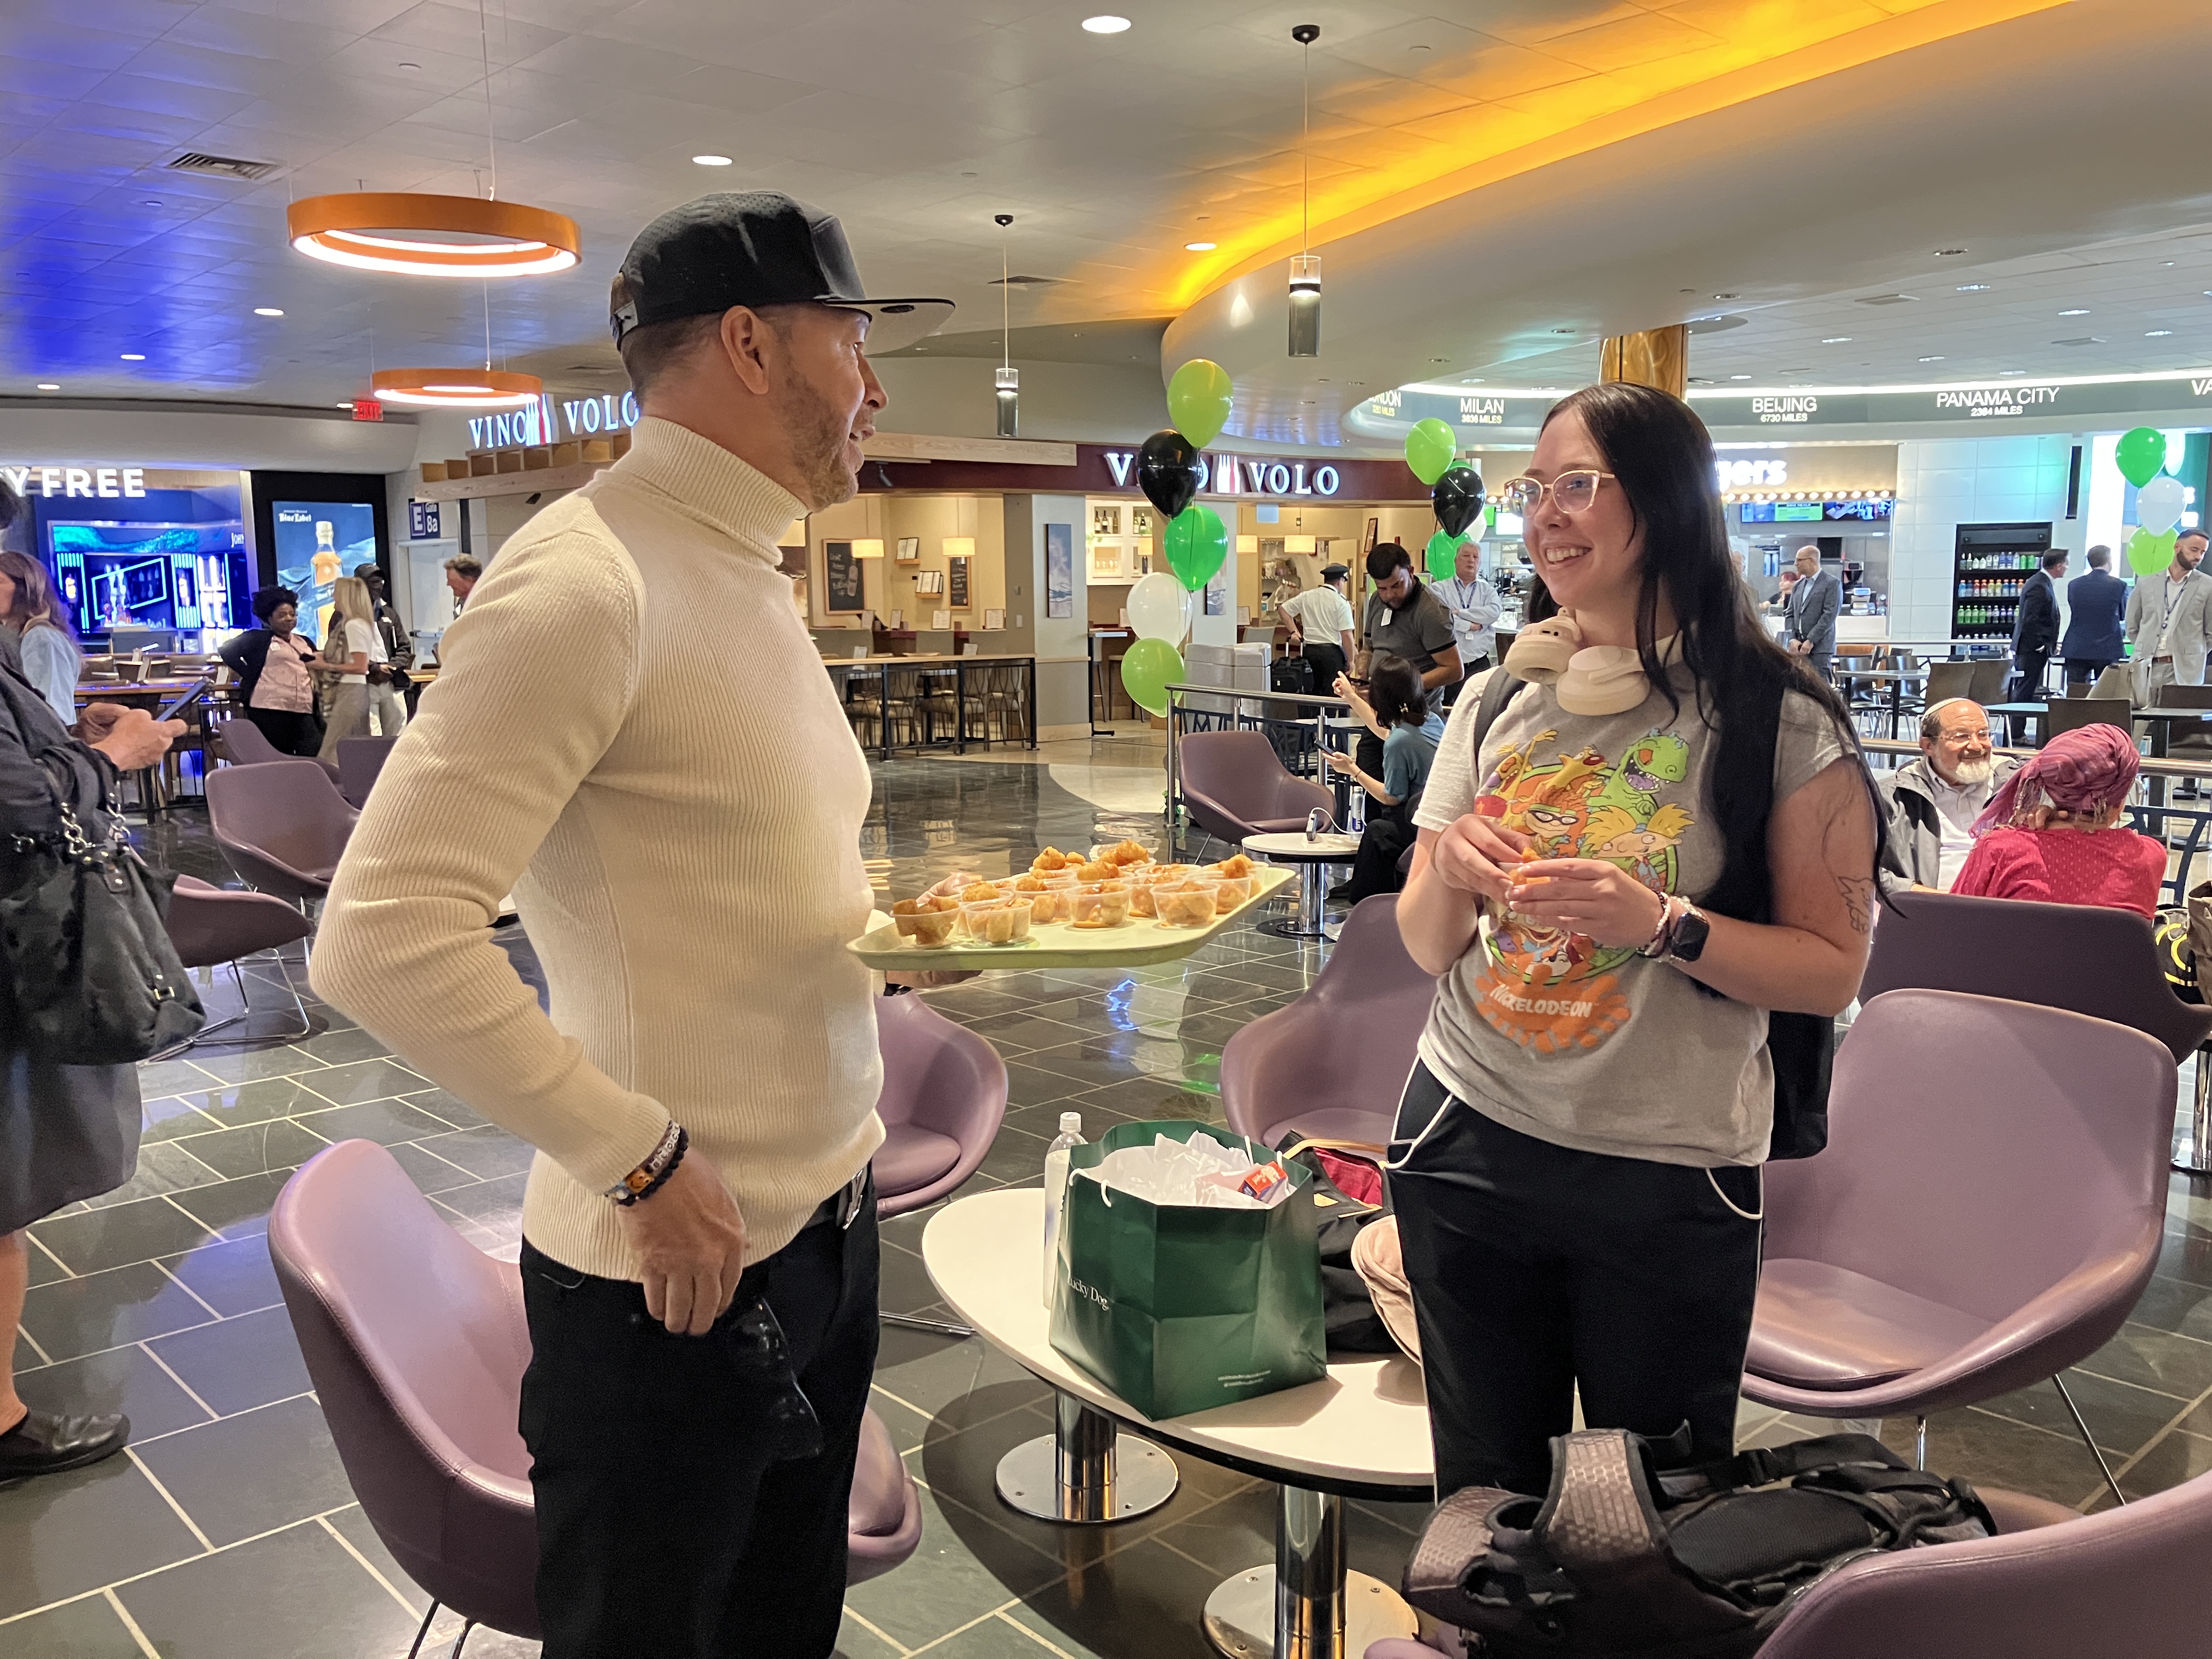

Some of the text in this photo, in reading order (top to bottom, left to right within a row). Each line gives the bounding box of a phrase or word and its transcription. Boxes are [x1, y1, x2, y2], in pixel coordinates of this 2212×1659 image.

[1460, 397, 1504, 414] MILAN
[1752, 397, 1817, 413] BEIJING
[1937, 387, 2059, 407] PANAMA CITY
[357, 402, 380, 419] EXIT
[1760, 413, 1808, 422] 6730 MILES
[1994, 405, 2023, 415] MILES
[469, 391, 640, 449] VINO VOLO
[1479, 415, 1502, 424] MILES
[1, 468, 145, 498] Y FREE
[1249, 461, 1339, 495] VOLO
[413, 506, 423, 531] E
[427, 515, 438, 532] 8a
[1489, 984, 1593, 1018] NICKELODEON
